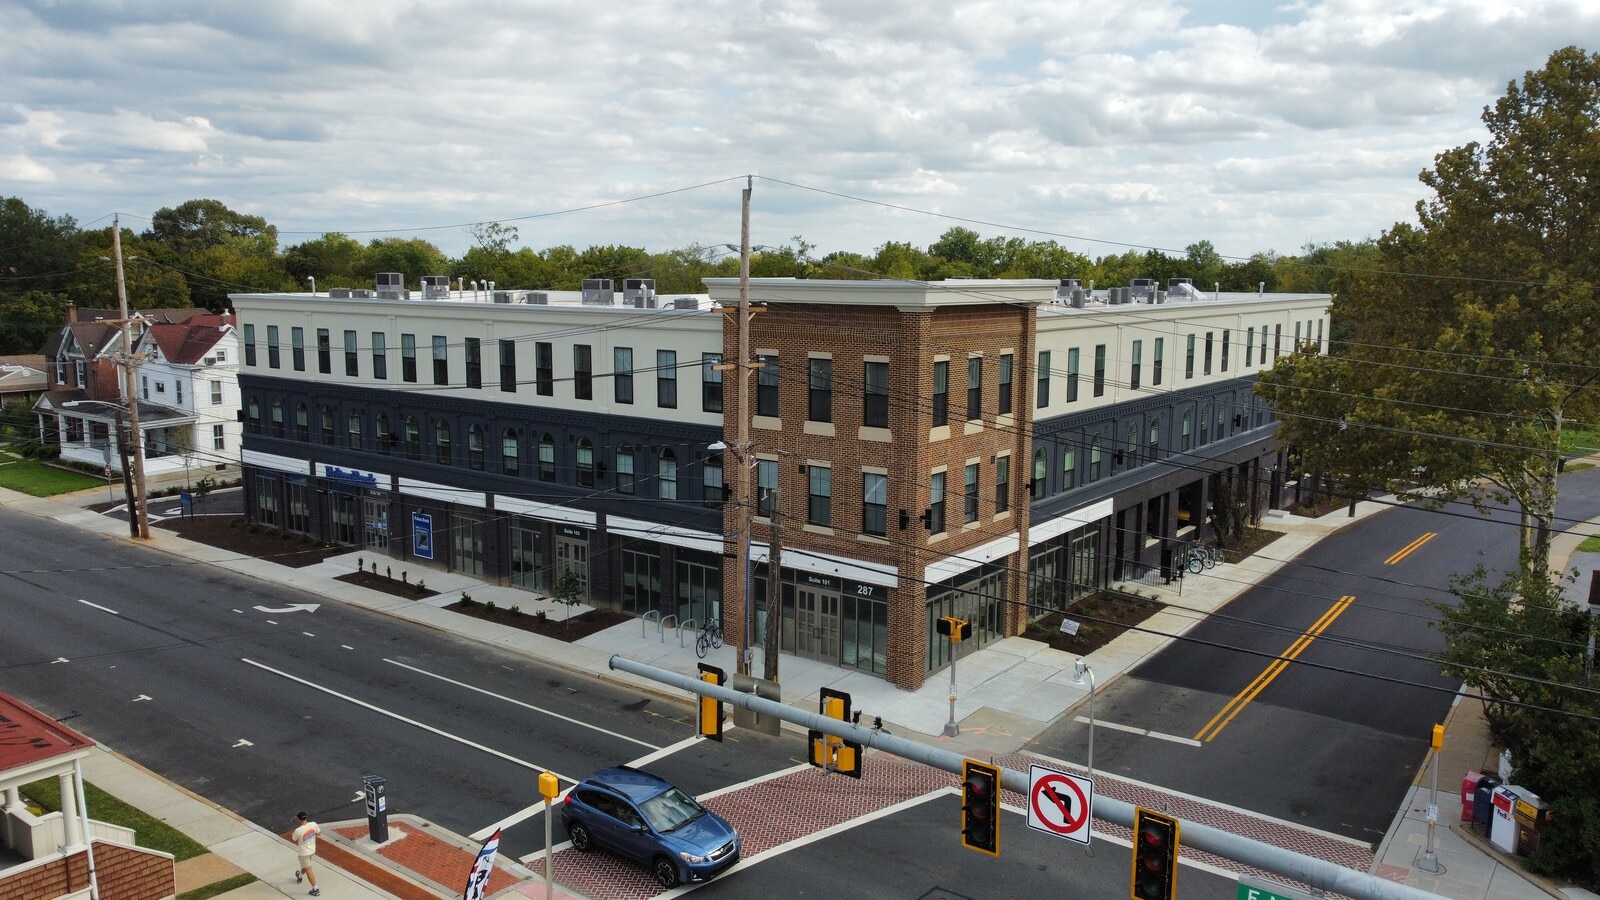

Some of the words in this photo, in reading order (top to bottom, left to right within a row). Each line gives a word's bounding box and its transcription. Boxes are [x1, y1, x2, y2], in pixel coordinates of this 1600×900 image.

[808, 576, 821, 584] Suite
[857, 585, 873, 596] 287
[1496, 809, 1511, 821] FedEx
